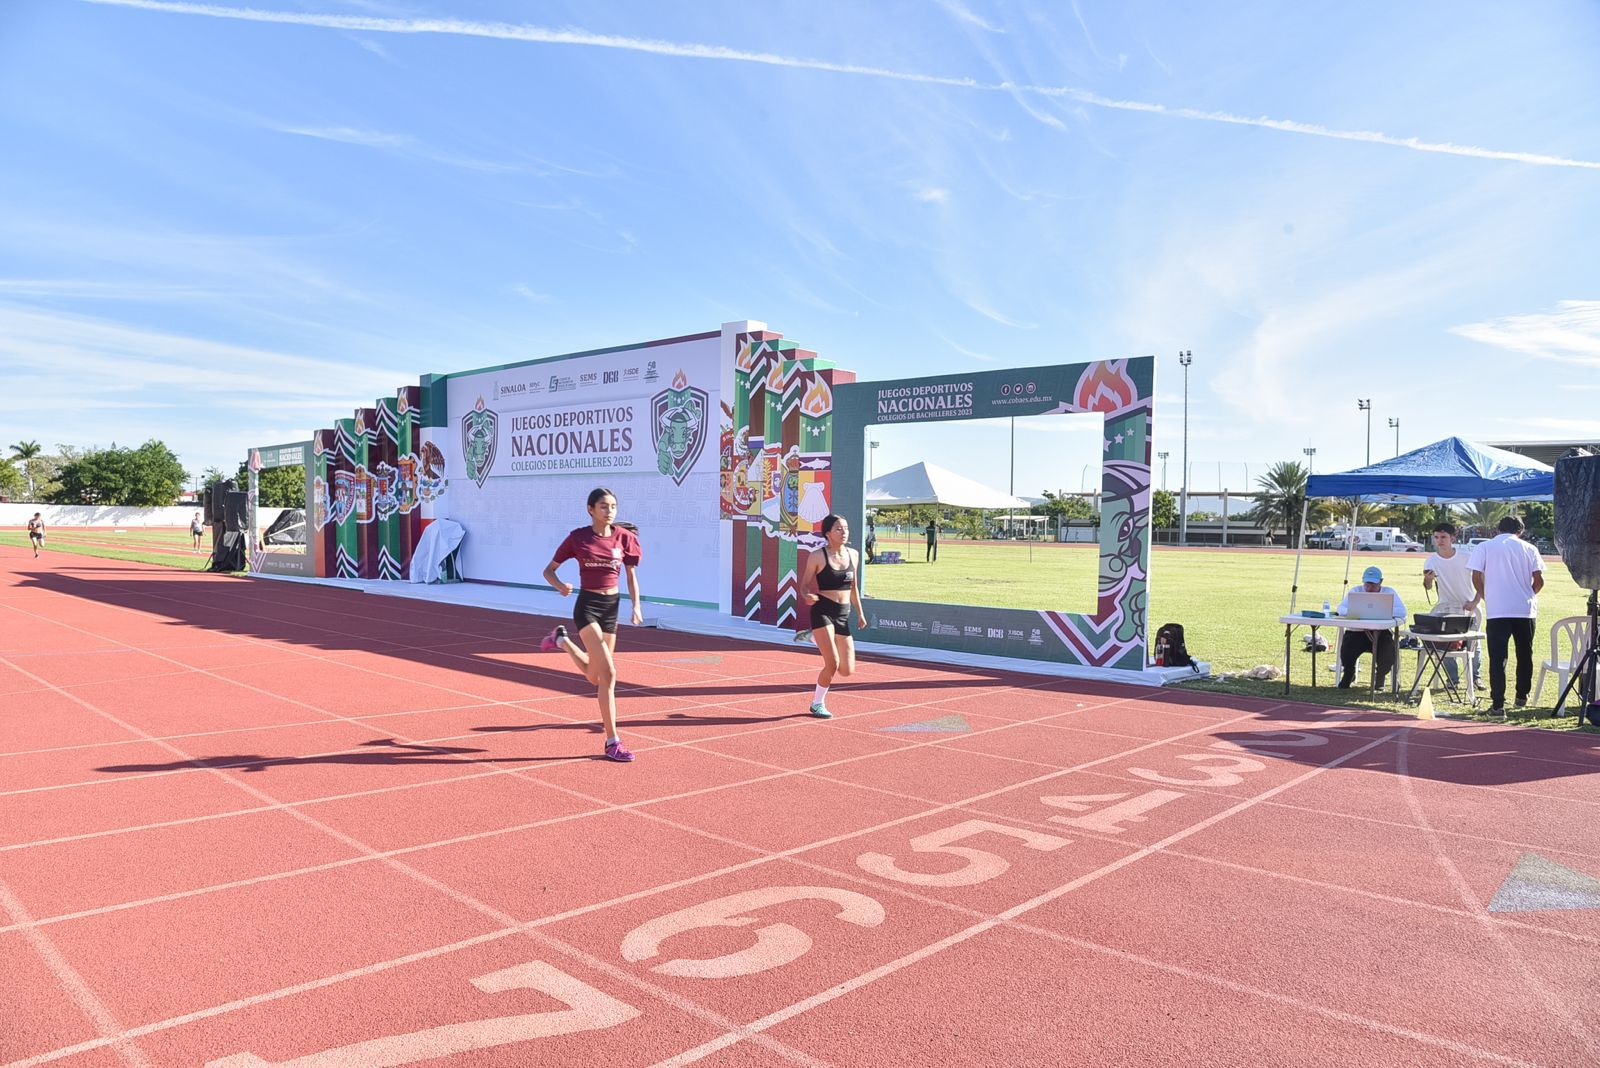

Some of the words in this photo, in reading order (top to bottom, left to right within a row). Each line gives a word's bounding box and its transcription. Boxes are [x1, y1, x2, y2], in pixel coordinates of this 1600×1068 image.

[500, 383, 526, 394] SINALOA
[579, 372, 598, 382] SEMS
[603, 370, 619, 384] DGB
[878, 387, 910, 400] JUEGOS
[912, 382, 974, 396] DEPORTIVOS
[877, 393, 973, 414] NACIONALES
[877, 412, 906, 422] COLEGIOS
[908, 412, 916, 420] DE
[916, 410, 957, 419] BACHILLERES
[958, 408, 973, 416] 2023
[511, 414, 551, 433] JUEGOS
[554, 406, 633, 428] DEPORTIVOS
[511, 427, 633, 458] NACIONALES
[511, 460, 546, 472] COLEGIOS
[548, 460, 558, 470] DE
[560, 456, 612, 470] BACHILLERES
[613, 455, 633, 467] 2023
[879, 618, 908, 628] SINALOA
[964, 625, 982, 634] SEMS
[987, 628, 1004, 639] DGB
[1207, 729, 1330, 759] 2
[1127, 753, 1267, 788] 3
[1040, 788, 1187, 835] 4
[856, 819, 1075, 887] 5
[620, 885, 886, 979] 6
[203, 959, 642, 1068] 7
